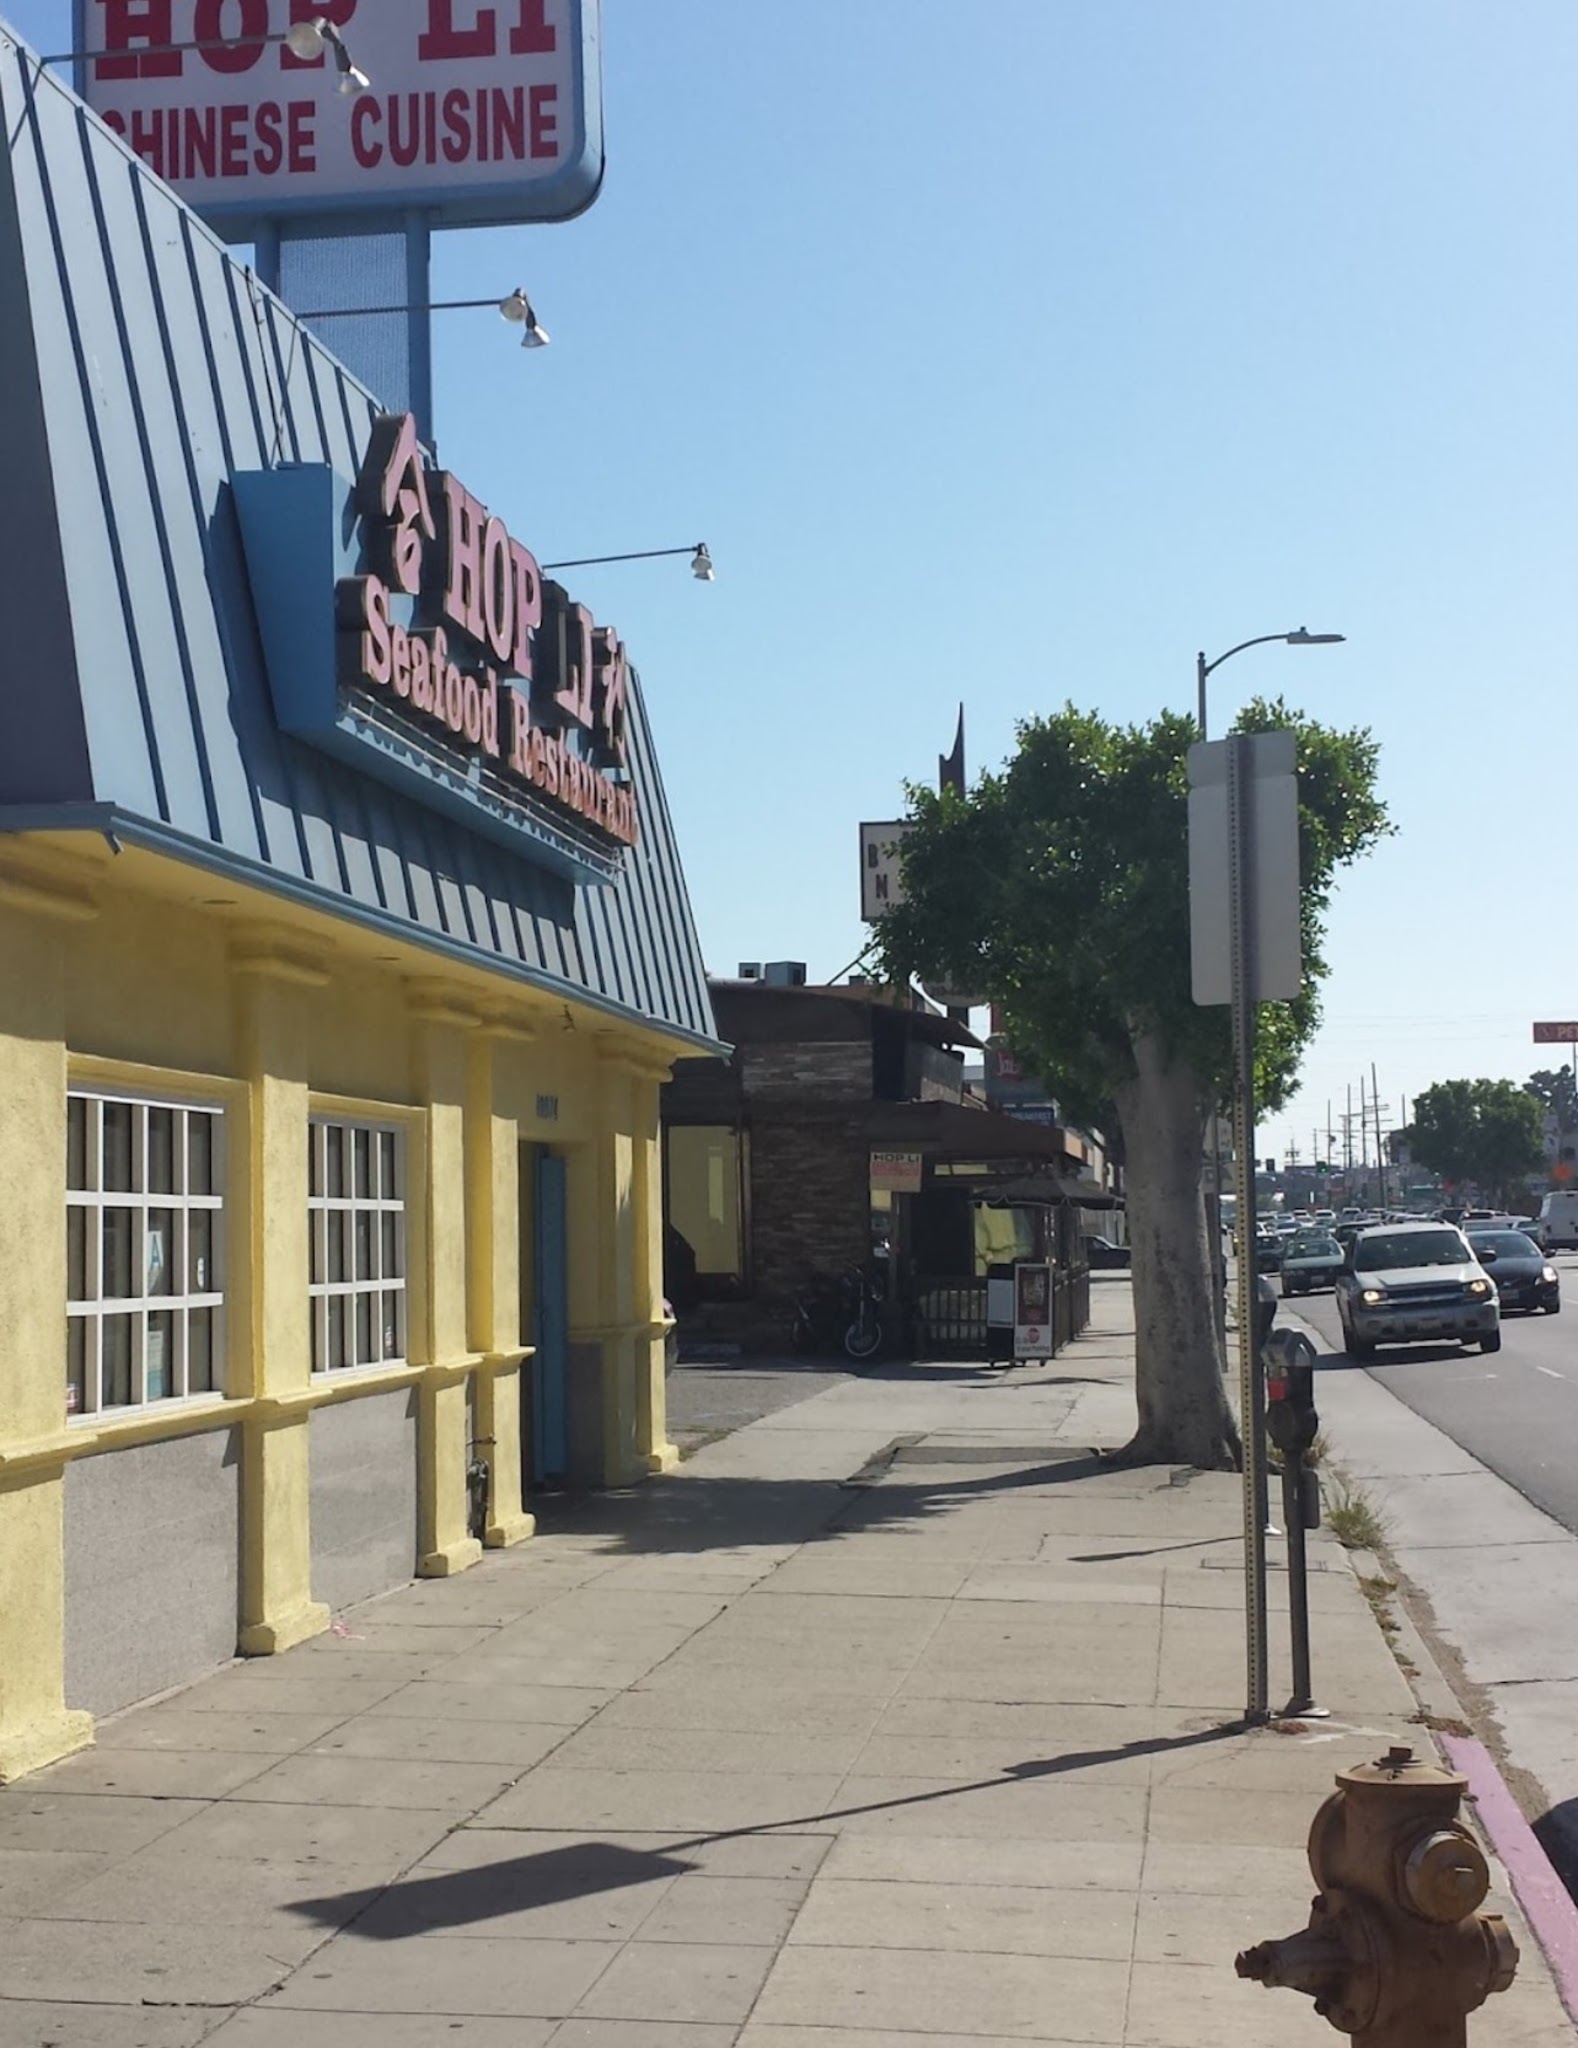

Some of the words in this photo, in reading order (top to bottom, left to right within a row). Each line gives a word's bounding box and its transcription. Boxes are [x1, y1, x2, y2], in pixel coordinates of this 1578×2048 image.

[96, 0, 356, 80] HOP
[418, 0, 556, 60] LI
[350, 84, 558, 168] CUISINE
[443, 471, 542, 680] HOP
[362, 574, 500, 758] Seafood
[509, 687, 638, 846] Restaurant
[874, 1153, 904, 1162] HOP
